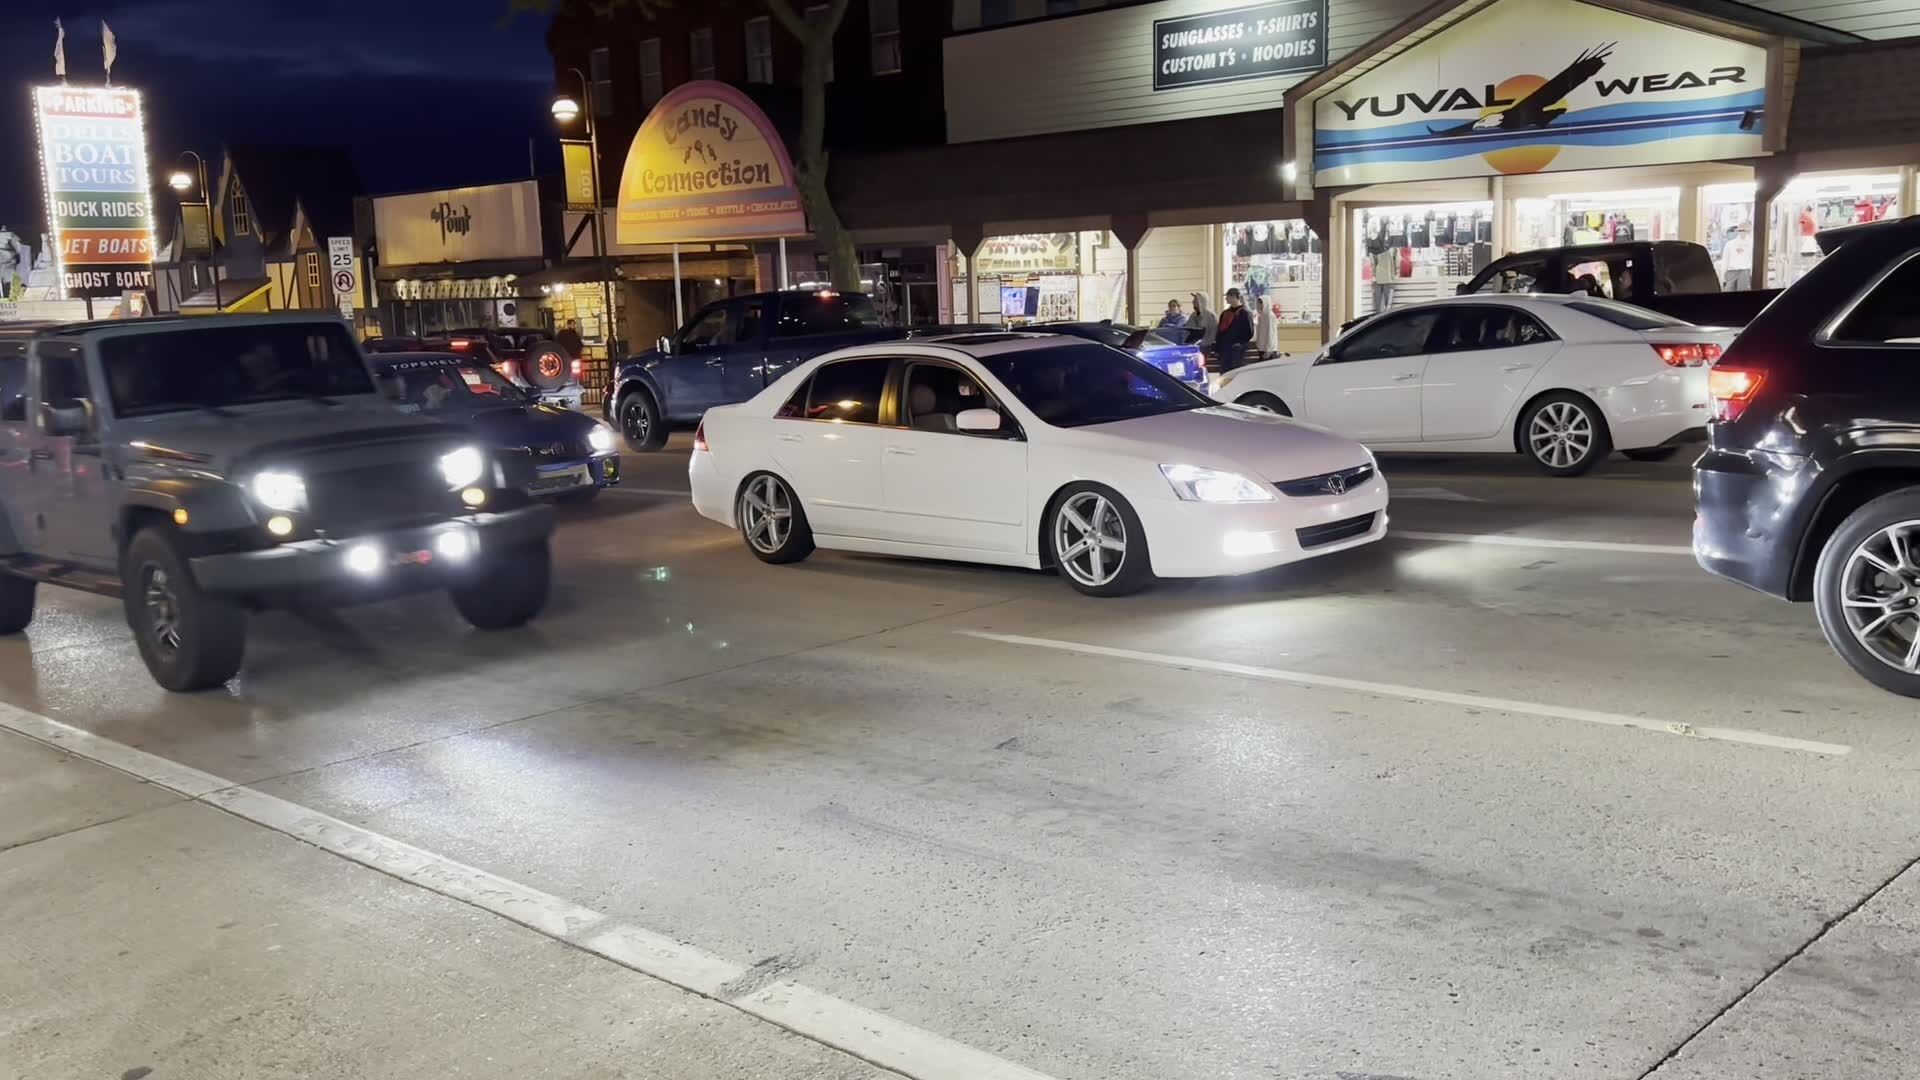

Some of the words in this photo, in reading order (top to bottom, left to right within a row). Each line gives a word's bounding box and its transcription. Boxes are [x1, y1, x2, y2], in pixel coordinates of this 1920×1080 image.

[1162, 22, 1244, 49] SUNGLASSES
[1256, 11, 1318, 35] T-SHIRTS
[1162, 53, 1216, 75] CUSTOM
[1252, 39, 1316, 63] HOODIES
[1333, 84, 1517, 121] YUVAL
[1595, 66, 1747, 97] WEAR
[53, 94, 127, 114] PARKING
[664, 103, 739, 145] Candy
[55, 142, 136, 165] BOAT
[55, 167, 137, 185] TOURS
[642, 159, 771, 194] Connection
[58, 200, 99, 217] DUCK
[101, 201, 145, 217] RIDES
[63, 238, 92, 254] JET
[98, 237, 148, 254] BOATS
[333, 254, 352, 266] 25
[64, 271, 111, 289] GHOST
[116, 271, 151, 289] BOAT
[390, 359, 462, 370] TOPSHELF
